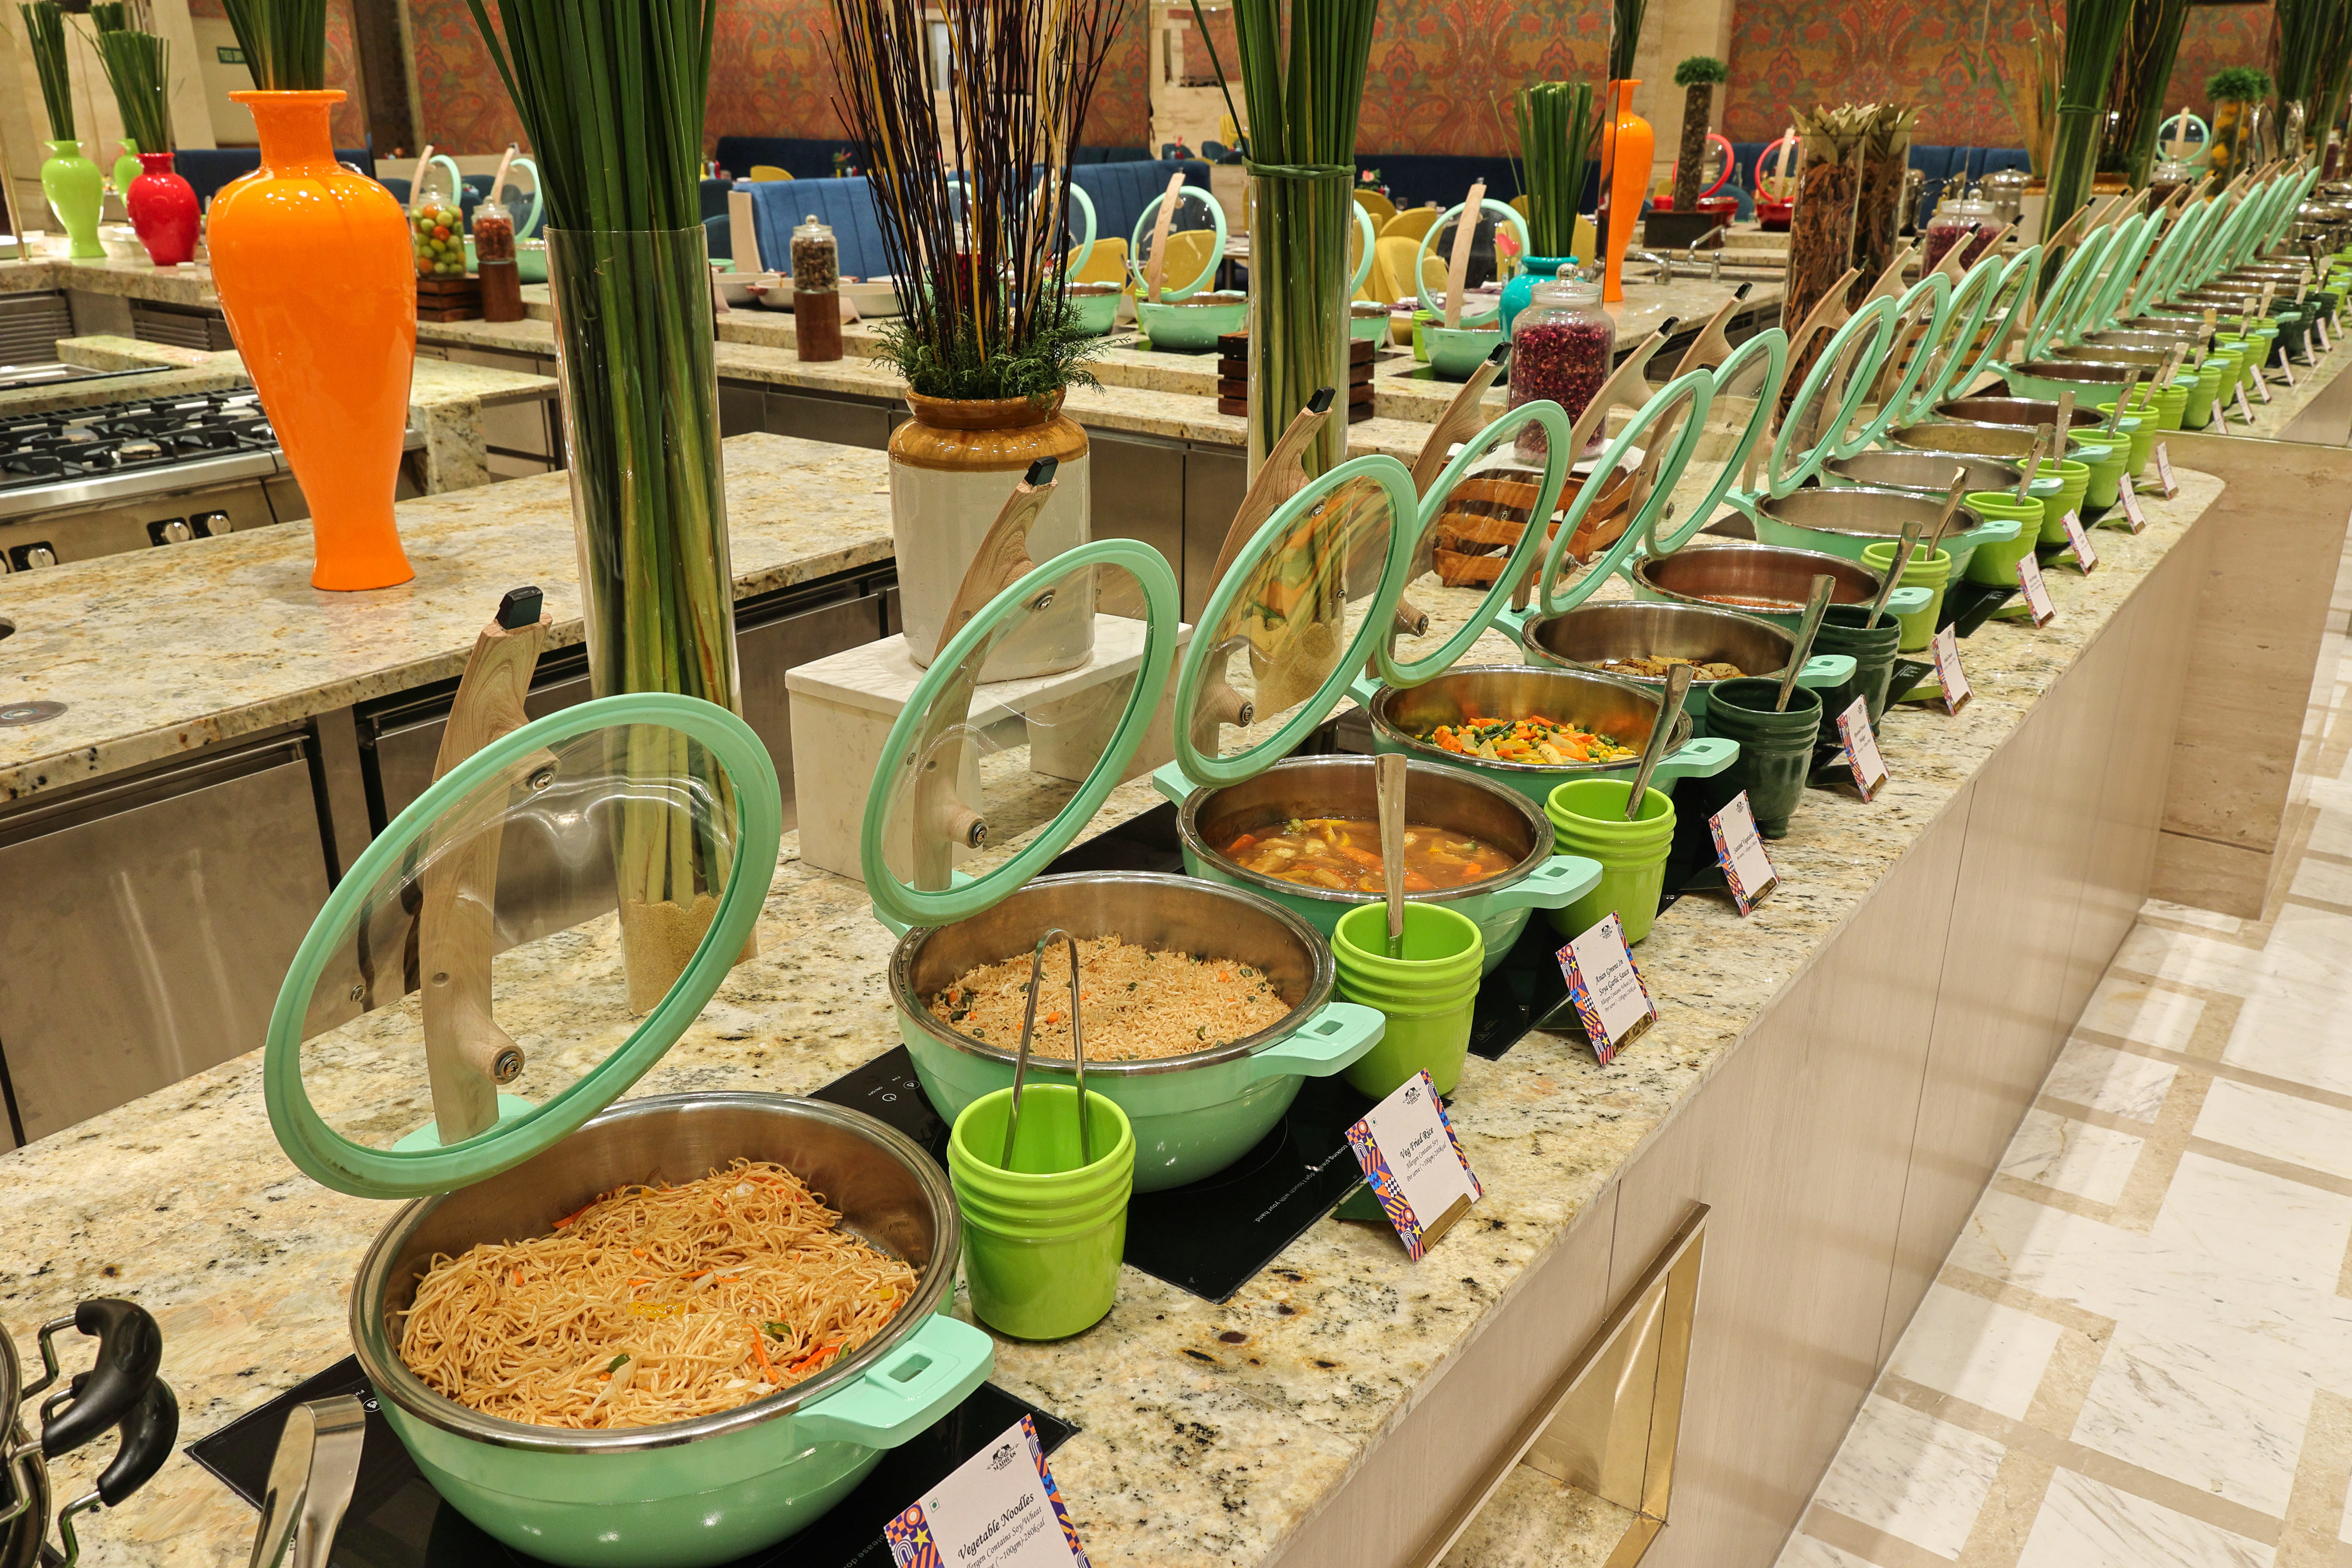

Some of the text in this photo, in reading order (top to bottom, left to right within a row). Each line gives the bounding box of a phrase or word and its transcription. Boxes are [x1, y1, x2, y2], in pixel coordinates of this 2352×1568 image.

[1595, 972, 1607, 985] Asian
[1606, 963, 1619, 977] Greens
[1599, 968, 1629, 996] Soya Garlic Sauce
[868, 1086, 883, 1096] ON/OFF
[1400, 1127, 1434, 1159] Veg Fried Rice
[1406, 1156, 1419, 1171] Allergen
[1418, 1144, 1433, 1158] Contains
[1412, 1167, 1421, 1177] serve
[1279, 1193, 1291, 1203] with
[1289, 1182, 1305, 1194] touch
[1268, 1200, 1280, 1211] your
[993, 1451, 1016, 1472] MADRAS
[958, 1493, 1034, 1560] Vegetable Noodles
[986, 1533, 1011, 1557] Contains
[1012, 1506, 1042, 1536] Soy/Wheat
[858, 1534, 885, 1558] please
